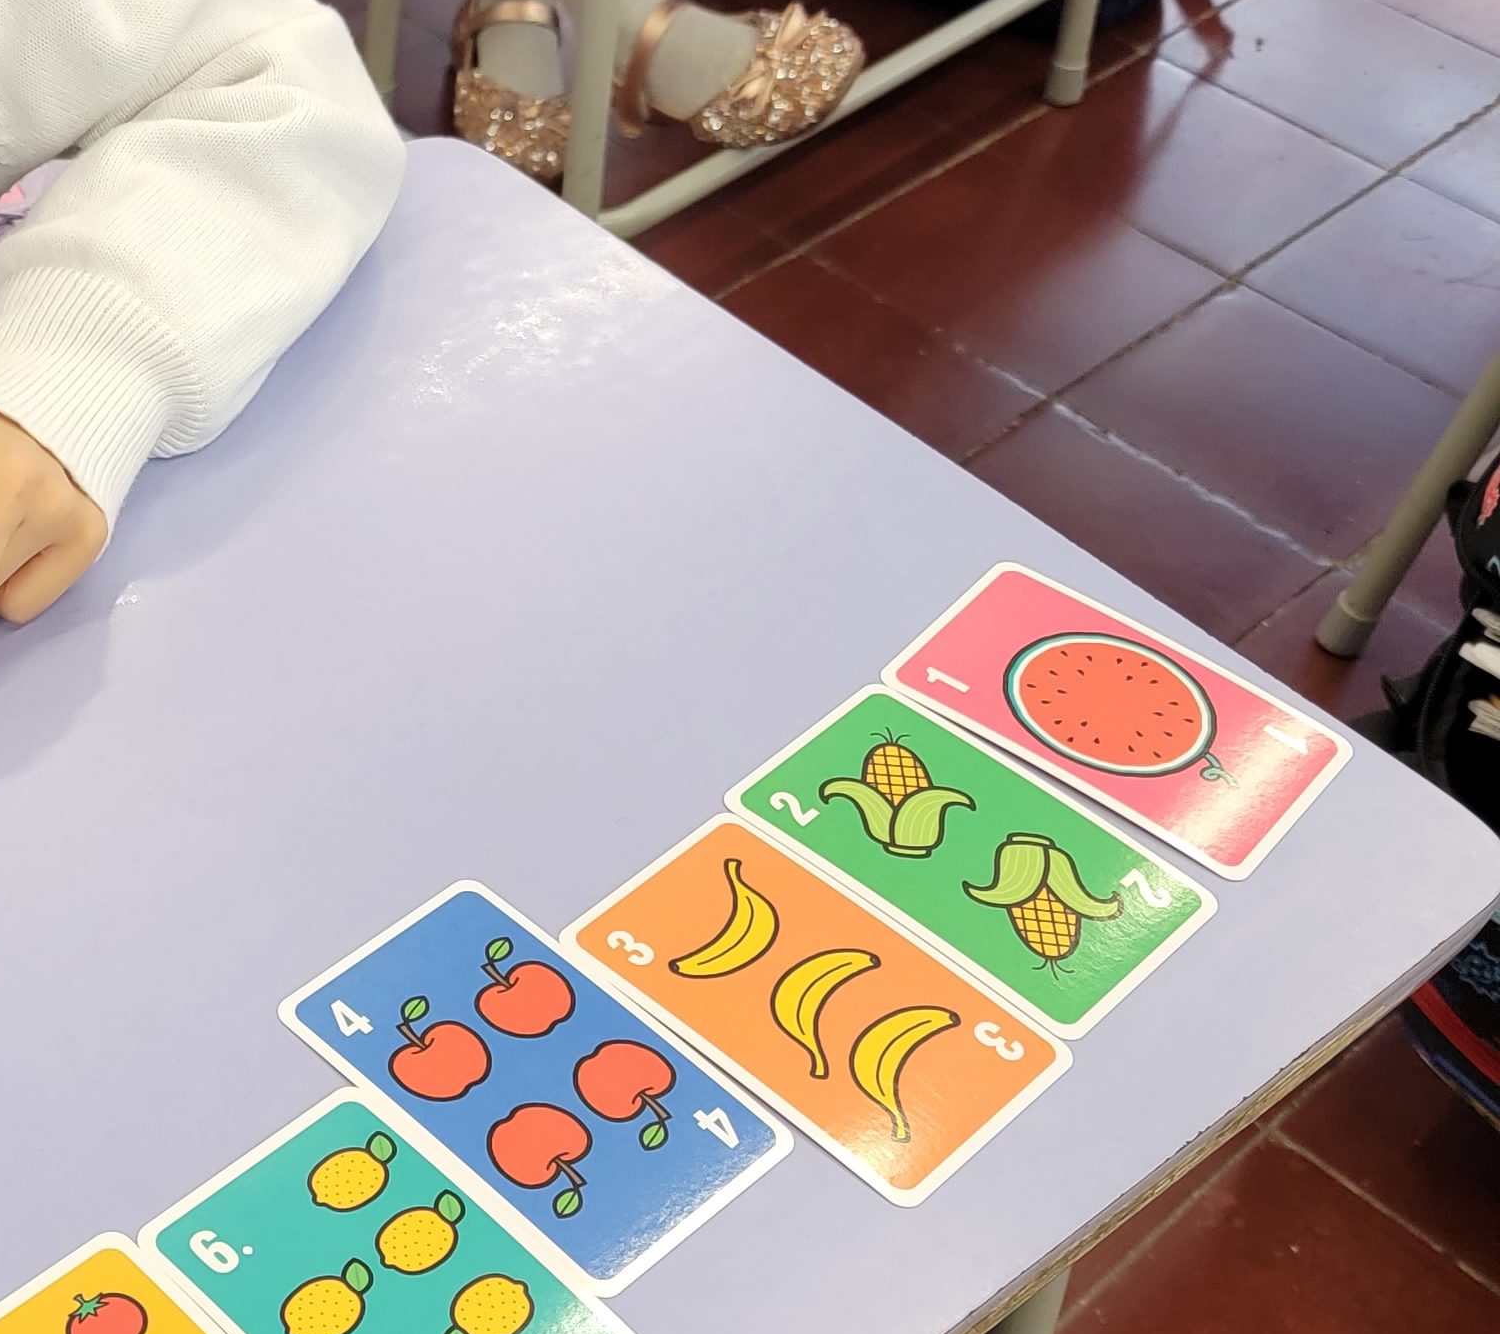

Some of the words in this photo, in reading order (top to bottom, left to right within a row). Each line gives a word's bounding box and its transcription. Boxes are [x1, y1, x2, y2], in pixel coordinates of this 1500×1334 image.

[926, 666, 970, 694] 1
[769, 791, 820, 827] 2
[1119, 868, 1173, 908] 2
[607, 930, 655, 967] 3
[330, 999, 374, 1037] 4
[974, 1021, 1026, 1062] 3
[692, 1107, 740, 1149] 4
